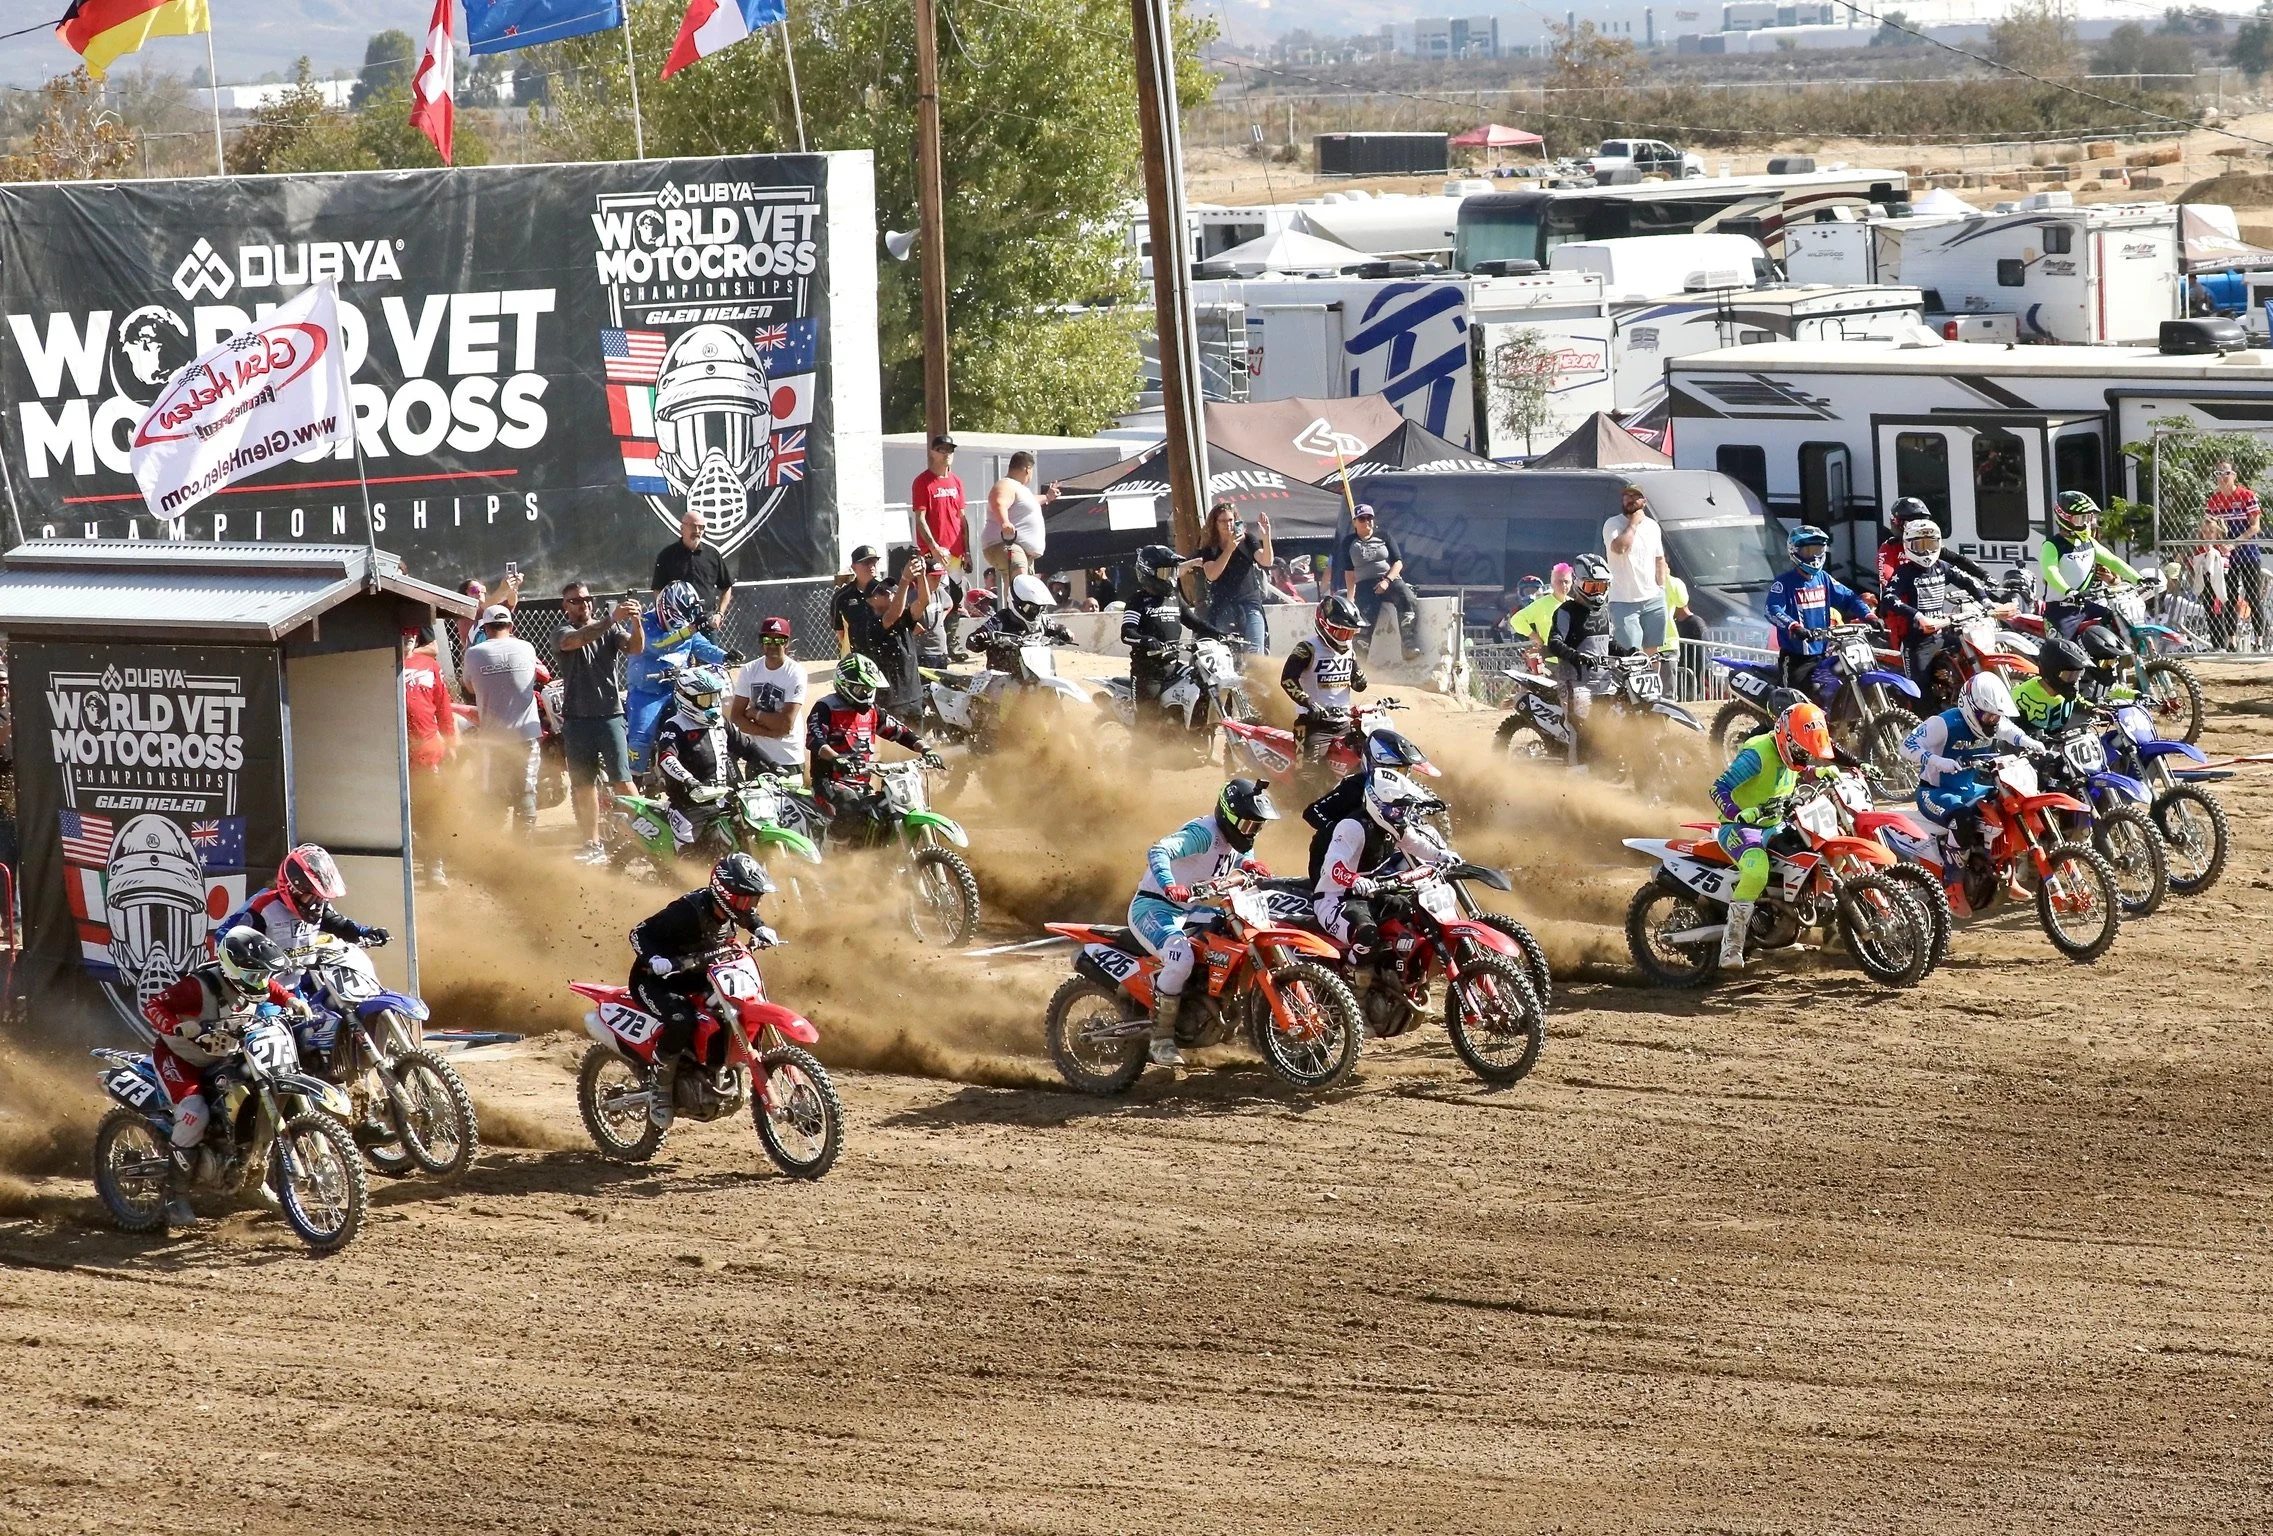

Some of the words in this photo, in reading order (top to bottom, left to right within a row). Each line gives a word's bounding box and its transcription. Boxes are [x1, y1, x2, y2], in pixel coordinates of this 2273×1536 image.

[684, 182, 754, 204] DUBYA
[591, 206, 740, 253] WORLD
[744, 204, 820, 243] VET
[595, 241, 817, 285] MOTOCROSS
[623, 278, 794, 302] CHAMPIONSHIPS
[645, 306, 703, 326] GLEN
[703, 304, 773, 323] HELEN
[382, 289, 557, 379] VET
[1207, 471, 1249, 498] ROY
[1242, 470, 1287, 490] LEE
[1958, 543, 2040, 562] FUEL
[125, 668, 185, 690] DUBYA
[1635, 675, 1661, 696] 224
[1731, 672, 1768, 695] 510
[46, 690, 174, 733] WORLD
[178, 696, 246, 735] VET
[51, 728, 244, 771] MOTOCROSS
[75, 768, 224, 789] CHAMPIONSHIPS
[95, 795, 144, 812] GLEN
[145, 796, 207, 813] HELEN
[1803, 803, 1837, 835] 75
[711, 874, 733, 900] 100%
[1688, 866, 1725, 894] 75
[1269, 892, 1308, 914] 622
[1096, 949, 1135, 979] 426
[1168, 950, 1182, 962] FLY
[1208, 950, 1229, 962] SUN
[331, 966, 360, 995] 14
[606, 1006, 647, 1039] 772
[252, 1035, 296, 1072] 273
[109, 1070, 156, 1107] 273
[182, 1112, 198, 1127] FLY
